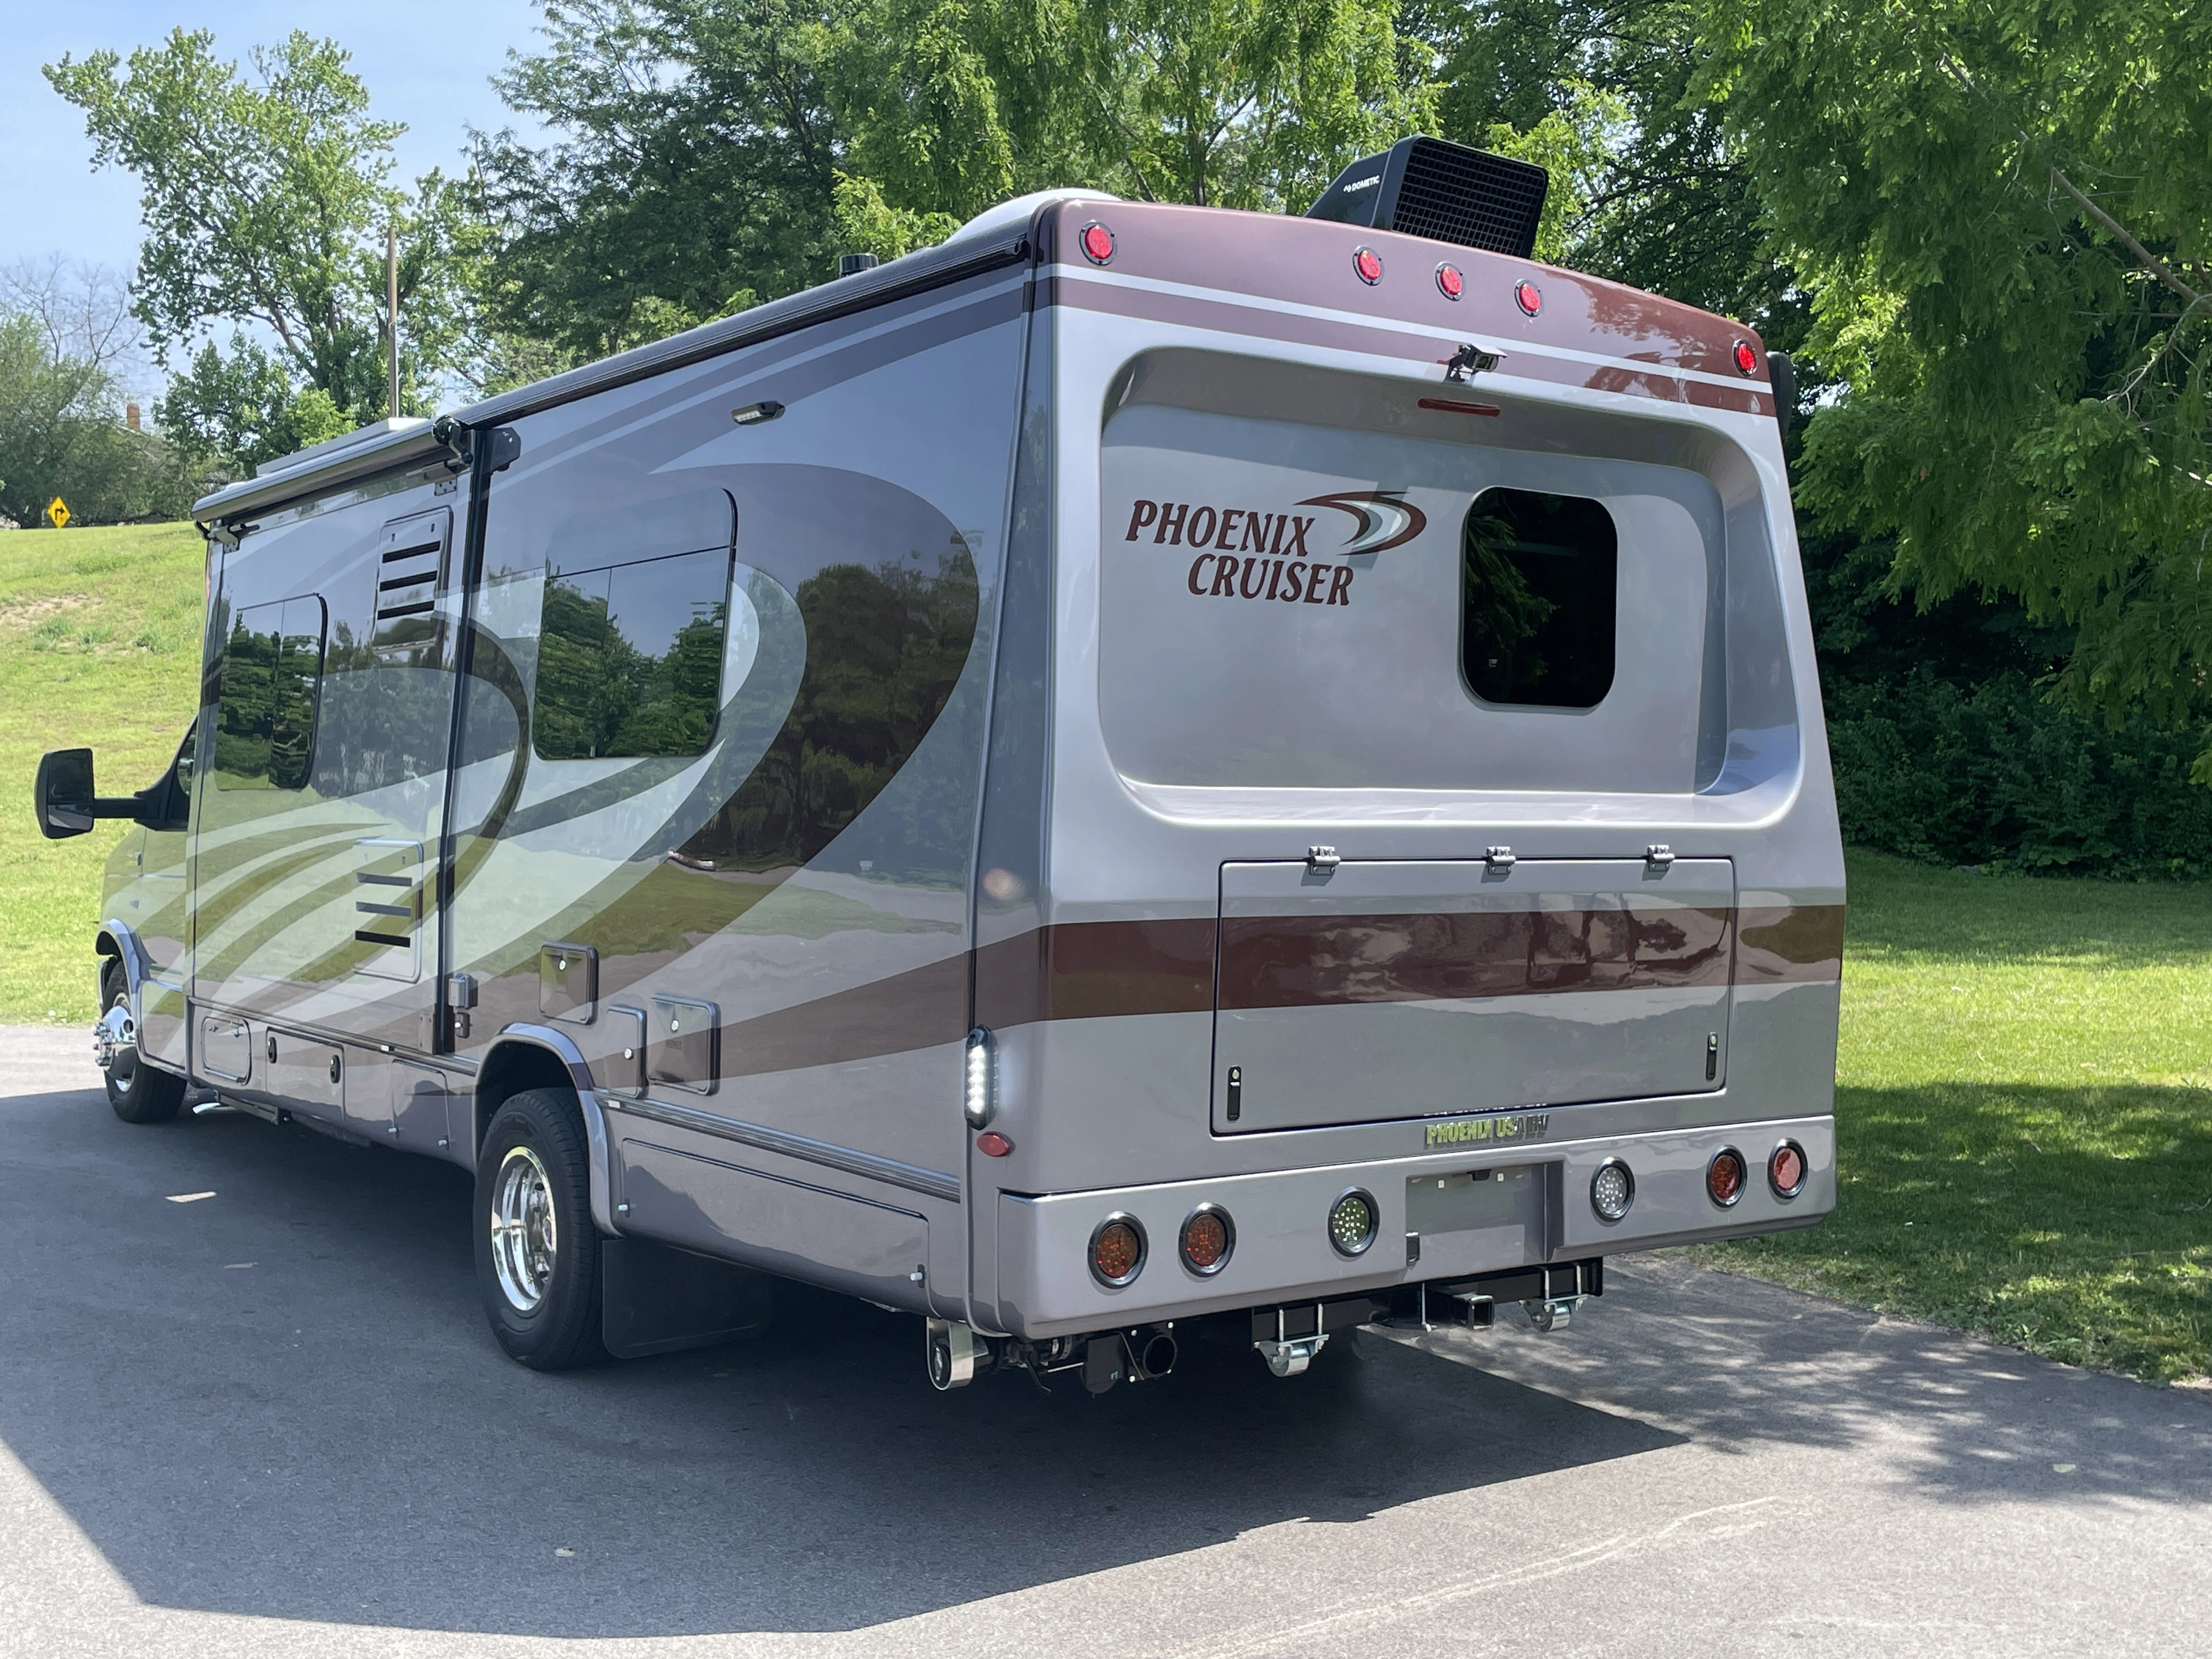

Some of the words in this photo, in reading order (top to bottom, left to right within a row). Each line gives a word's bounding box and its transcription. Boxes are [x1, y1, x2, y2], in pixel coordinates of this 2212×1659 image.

[1352, 175, 1380, 191] DOMETIC
[1125, 500, 1315, 557] PHOENIX
[1188, 554, 1354, 606] CRUISER
[1426, 1119, 1493, 1144] PHOENIX
[1496, 1115, 1525, 1138] USA
[1527, 1114, 1549, 1133] RV
